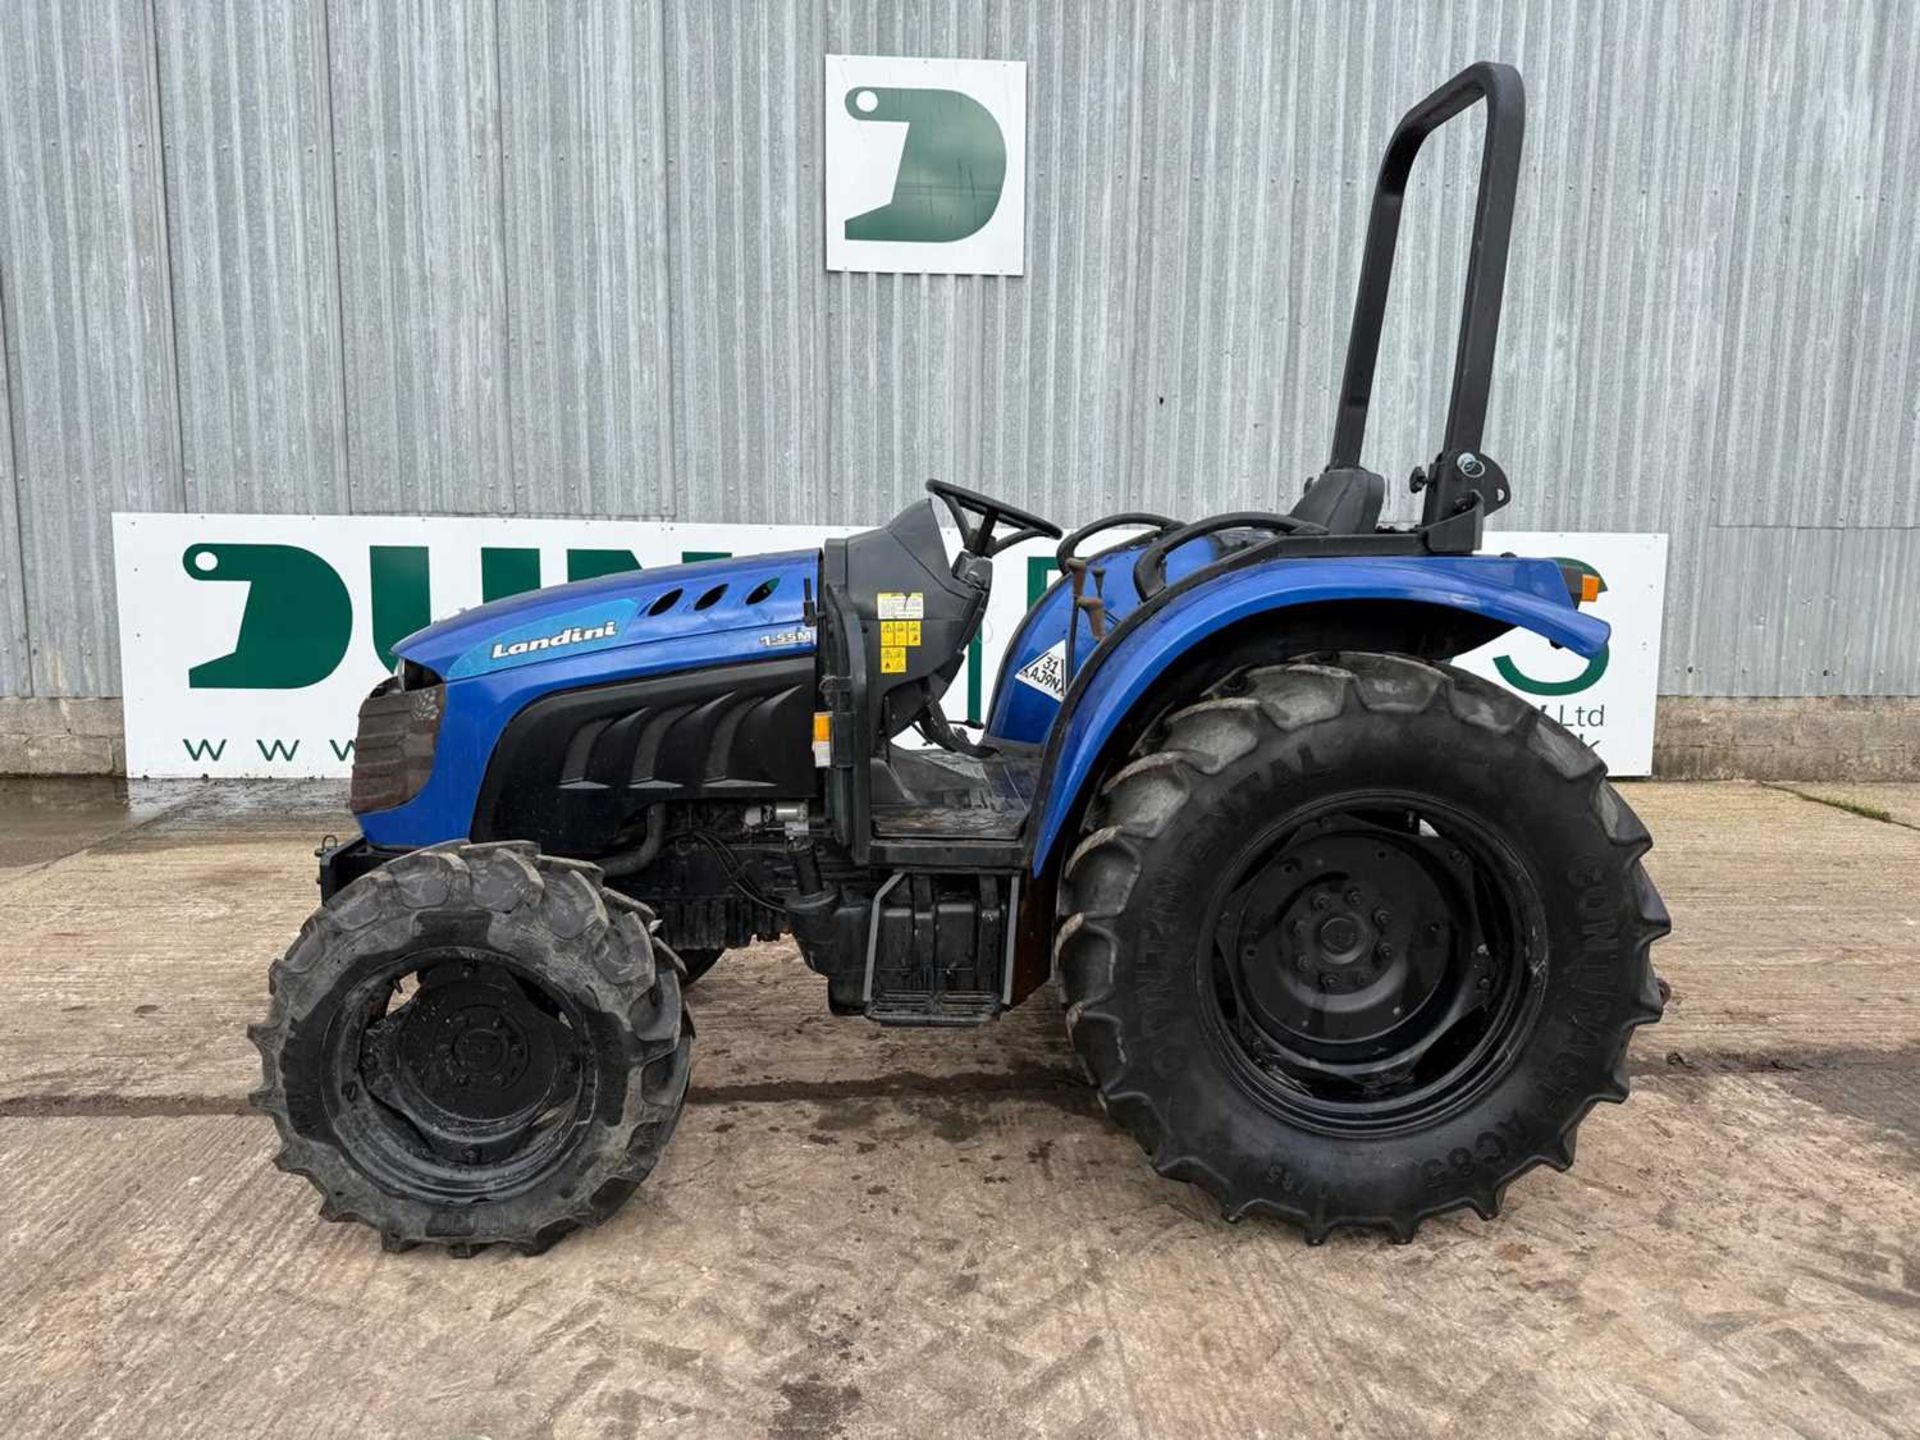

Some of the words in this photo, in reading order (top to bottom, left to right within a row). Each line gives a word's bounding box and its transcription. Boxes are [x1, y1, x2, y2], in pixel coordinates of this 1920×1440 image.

[491, 620, 617, 660] Landini
[1042, 656, 1060, 675] 31
[1559, 704, 1605, 727] Ltd
